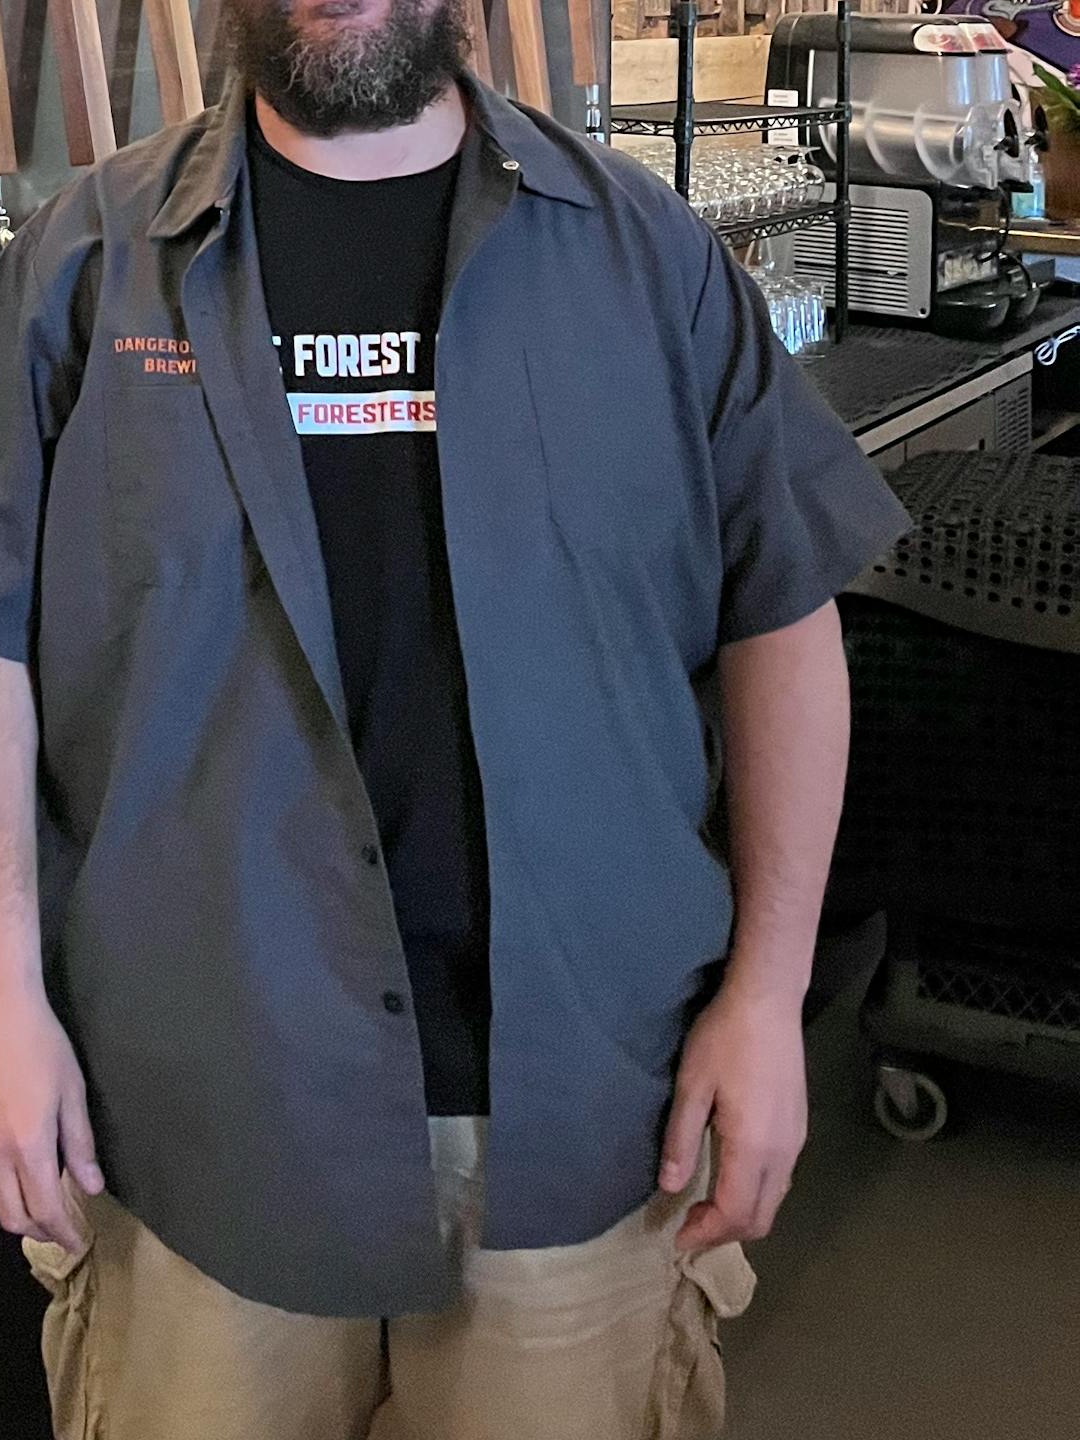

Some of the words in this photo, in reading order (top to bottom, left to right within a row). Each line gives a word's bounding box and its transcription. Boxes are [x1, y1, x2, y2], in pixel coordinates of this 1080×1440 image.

[114, 337, 194, 355] DANGERO
[294, 331, 420, 378] FOREST
[298, 400, 436, 425] FORESTERS
